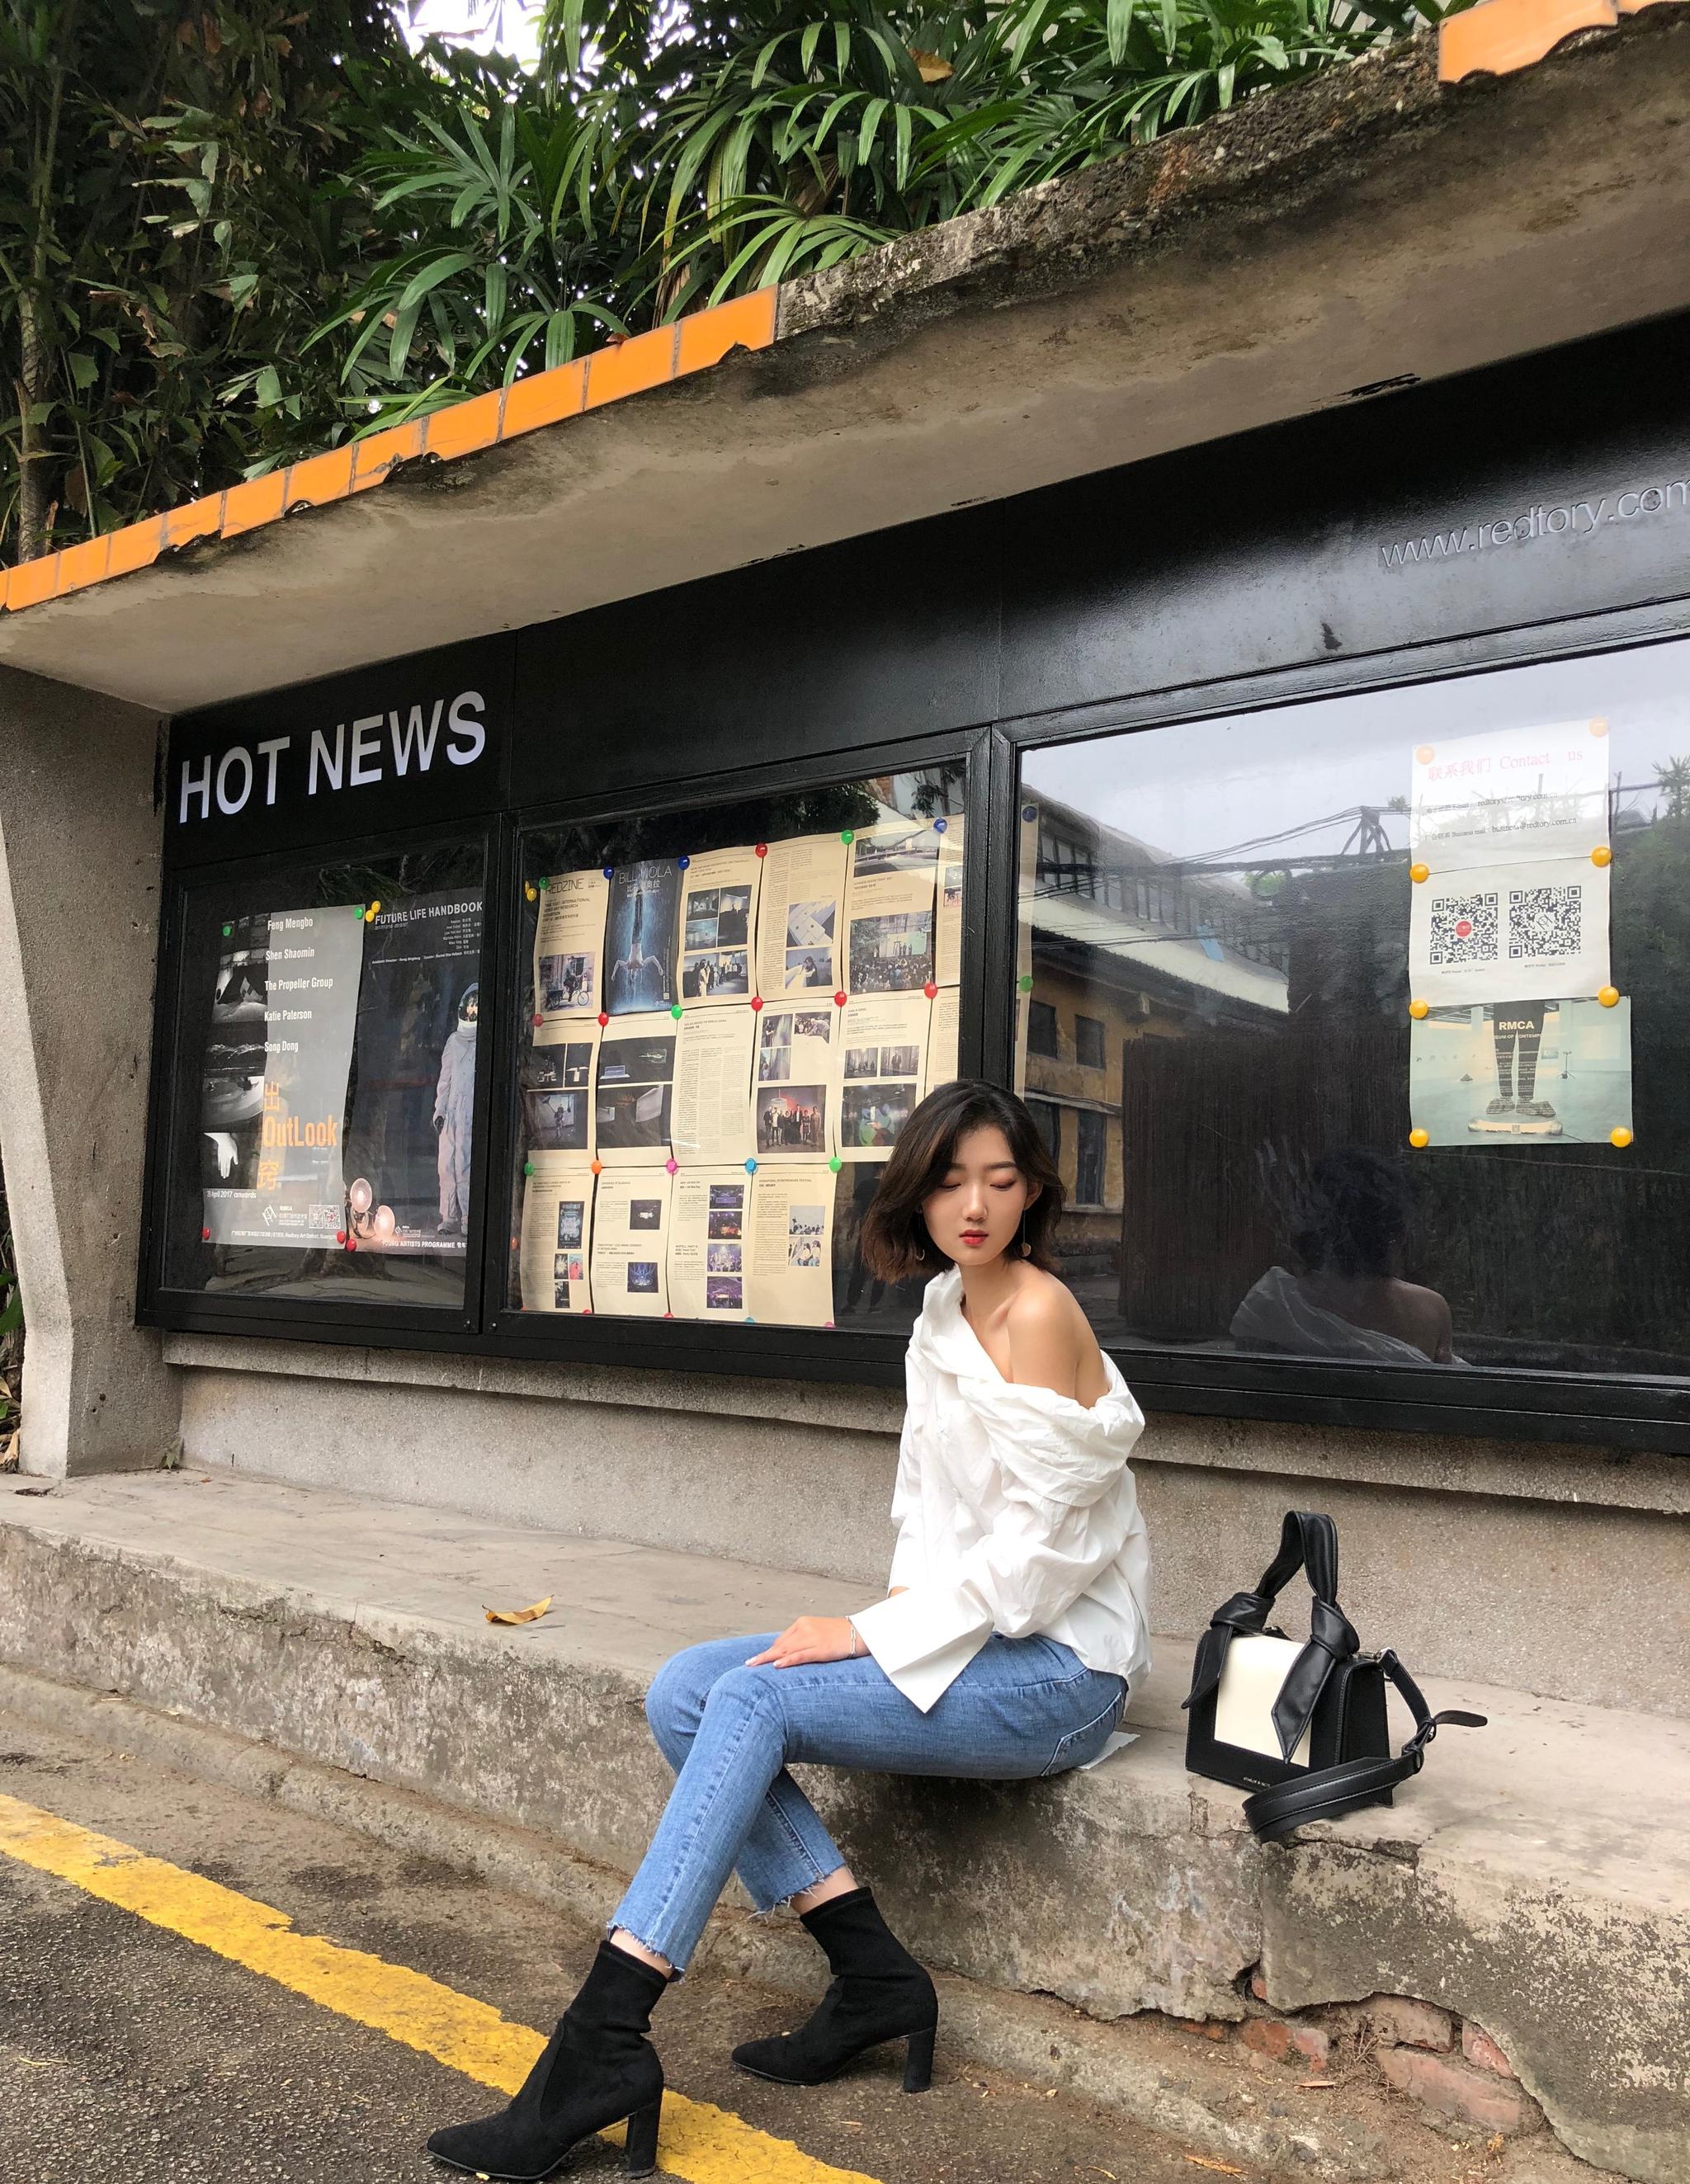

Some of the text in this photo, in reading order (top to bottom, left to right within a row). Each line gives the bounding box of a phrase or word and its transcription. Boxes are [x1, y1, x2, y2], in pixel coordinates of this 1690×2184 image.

[179, 691, 486, 824] HOT NEWS
[1428, 750, 1584, 781] 联系我们 Contact us
[375, 901, 483, 925] FUTURE LIFE HANDBOOK
[267, 917, 314, 932] Feng Mengbo
[265, 946, 314, 961] Shen Shaomin
[264, 976, 333, 991] The Propeller Group
[264, 1009, 312, 1021] Katie Paterson
[1499, 1021, 1535, 1031] RMCA
[264, 1040, 299, 1054] Song Dong
[262, 1115, 338, 1148] OutLook
[220, 1190, 233, 1198] 2017
